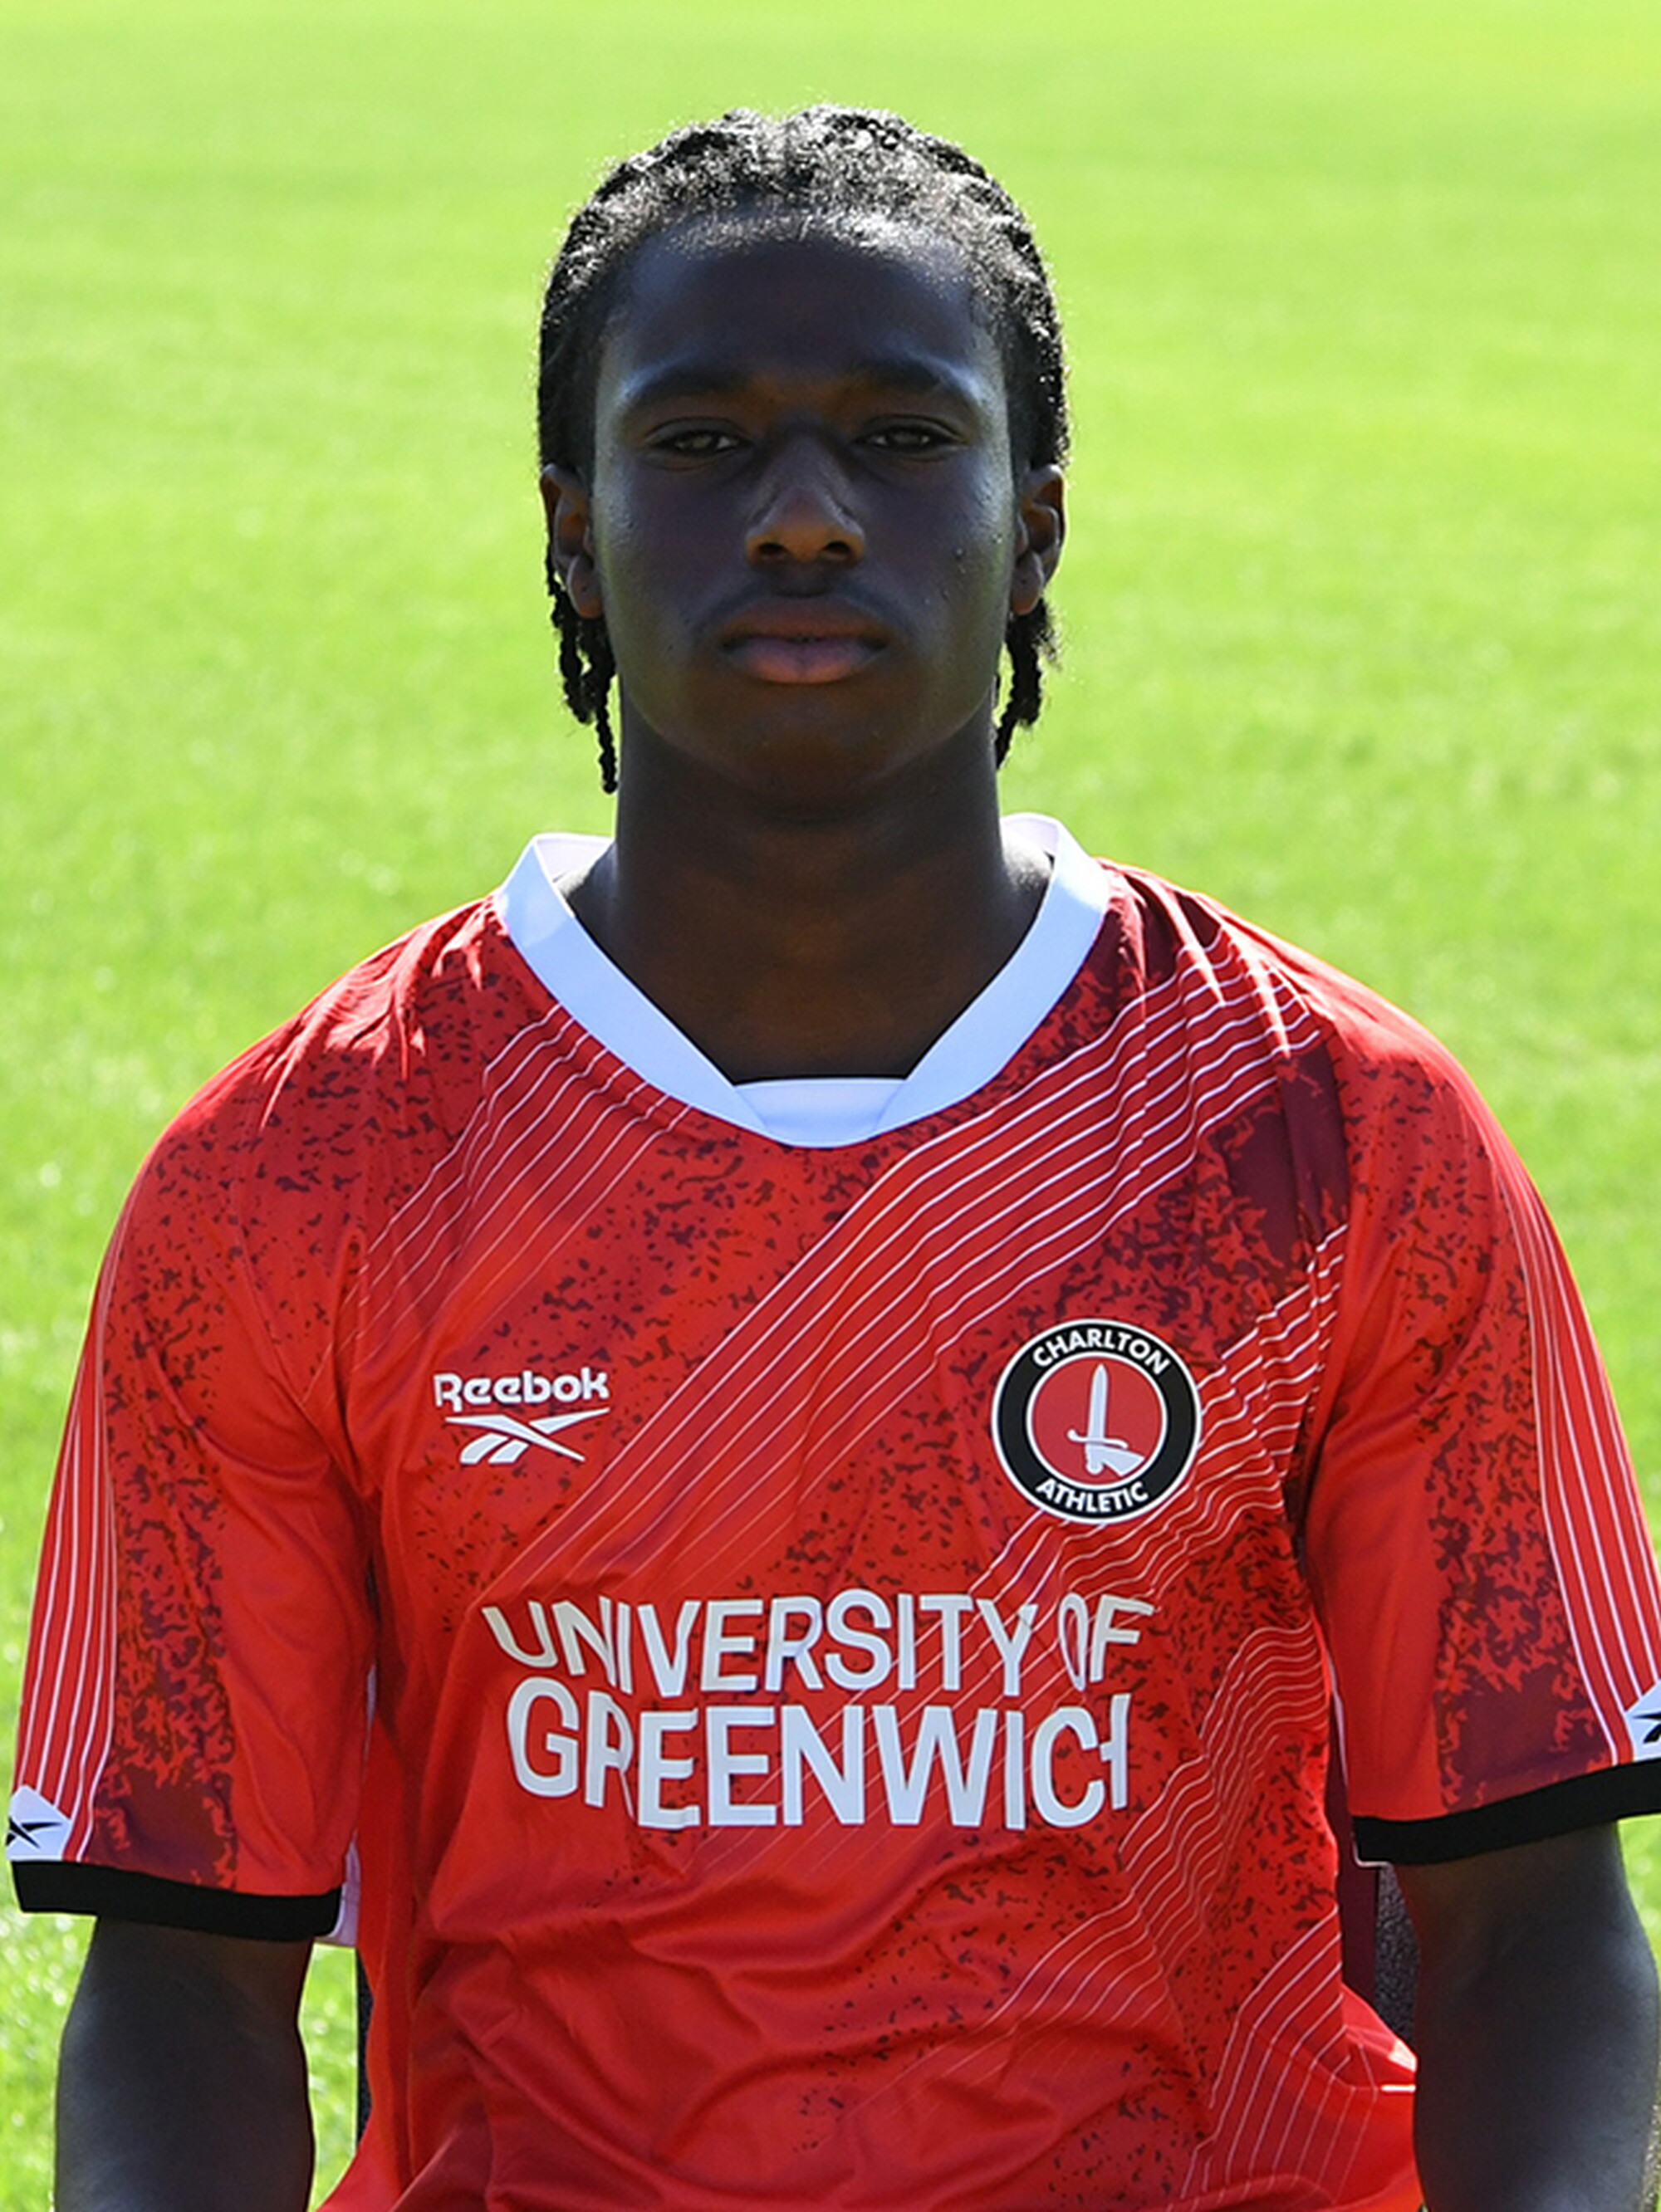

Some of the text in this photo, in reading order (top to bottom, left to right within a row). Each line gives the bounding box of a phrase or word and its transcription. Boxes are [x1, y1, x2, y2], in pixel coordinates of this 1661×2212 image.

[1032, 1329, 1170, 1375] CHARLTON
[434, 1367, 610, 1412] Reebok
[1036, 1478, 1148, 1511] ATHLETIC
[482, 1588, 1154, 1696] UNIVERSITY OF
[507, 1676, 1132, 1830] GREENWICH
